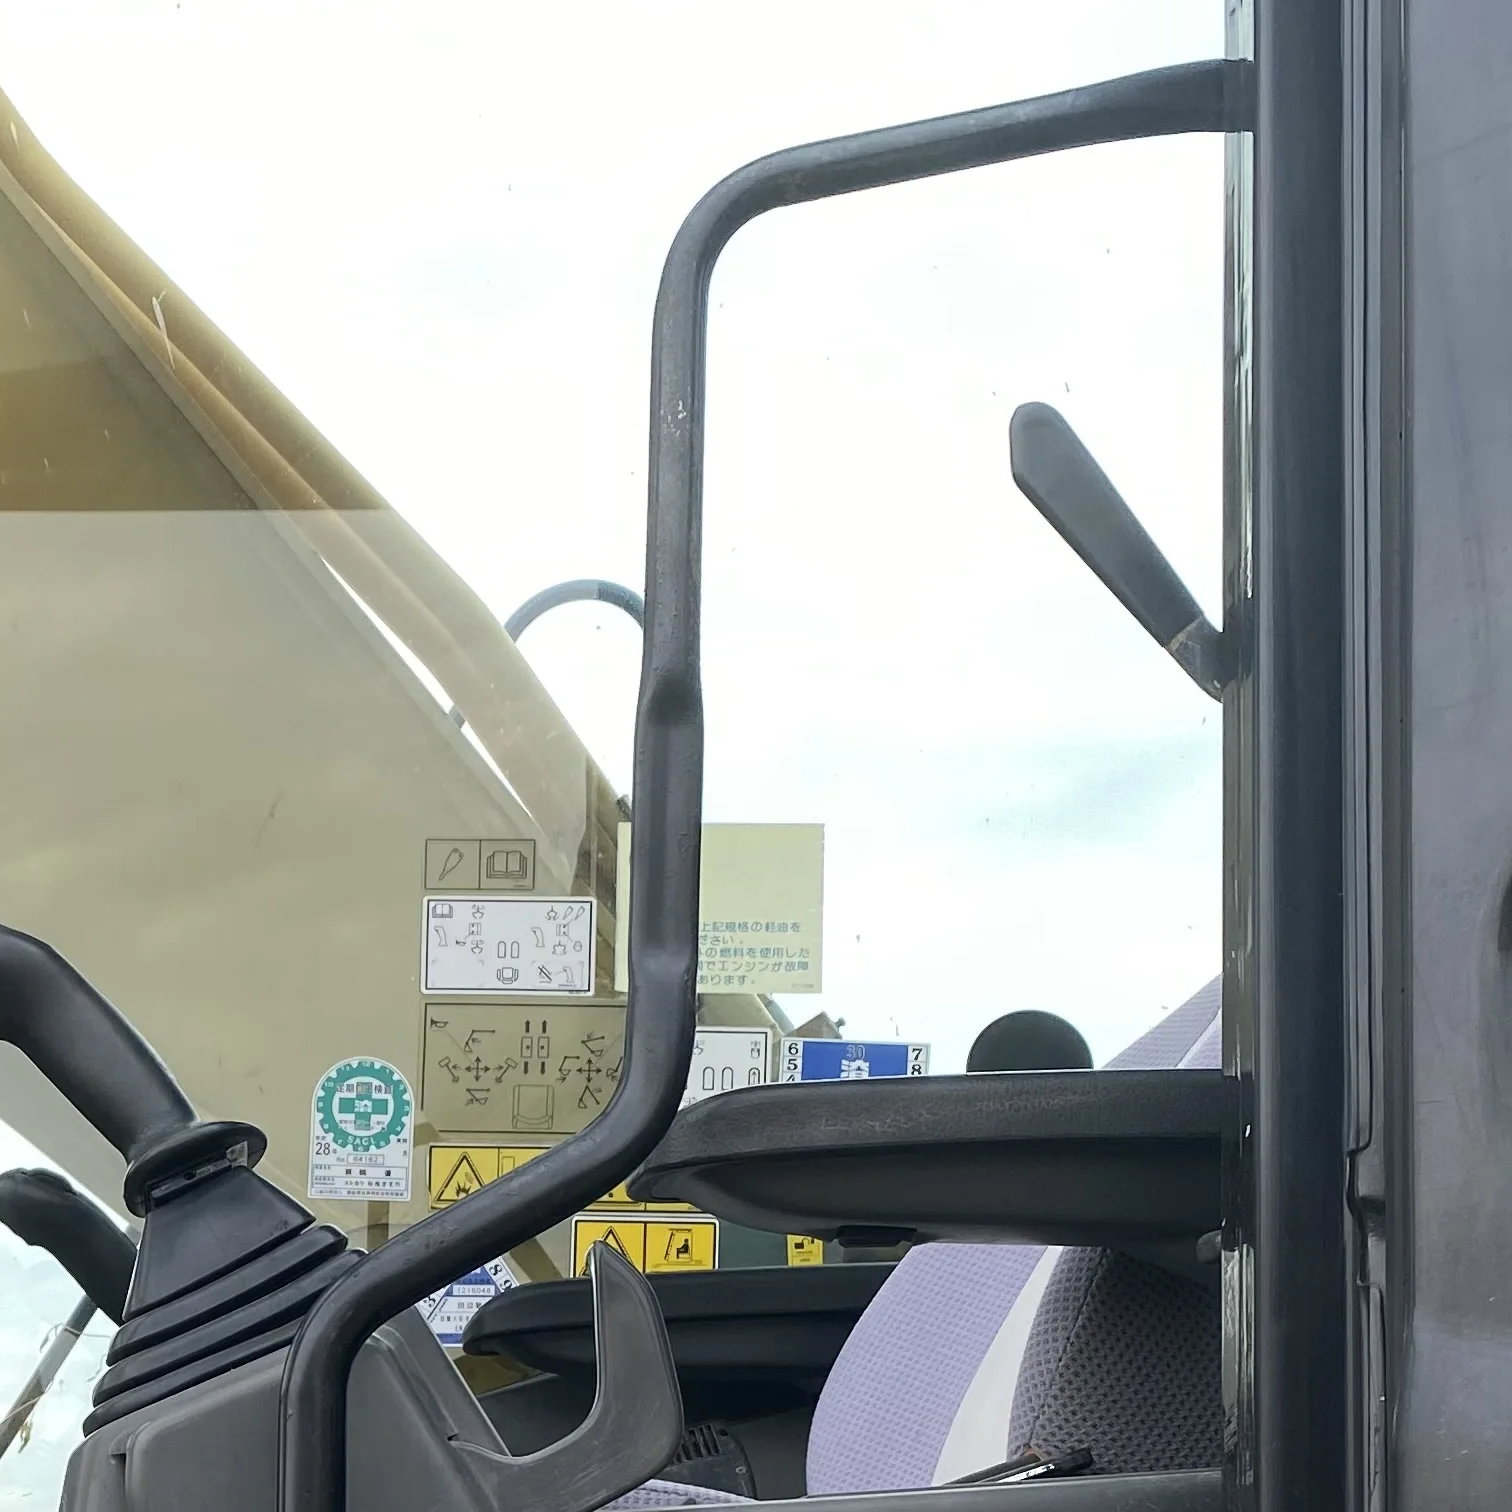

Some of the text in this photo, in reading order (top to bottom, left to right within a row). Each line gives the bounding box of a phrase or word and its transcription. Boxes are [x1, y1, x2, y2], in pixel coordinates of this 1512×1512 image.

[700, 921, 801, 933] 上記規格の軽油を
[699, 948, 810, 958] の燃料を使用した
[788, 1043, 799, 1056] 6
[846, 1045, 865, 1060] 30
[912, 1048, 923, 1061] 7
[787, 1058, 798, 1071] 5
[911, 1064, 922, 1075] 8
[315, 1142, 330, 1155] 28
[489, 1264, 502, 1276] 8
